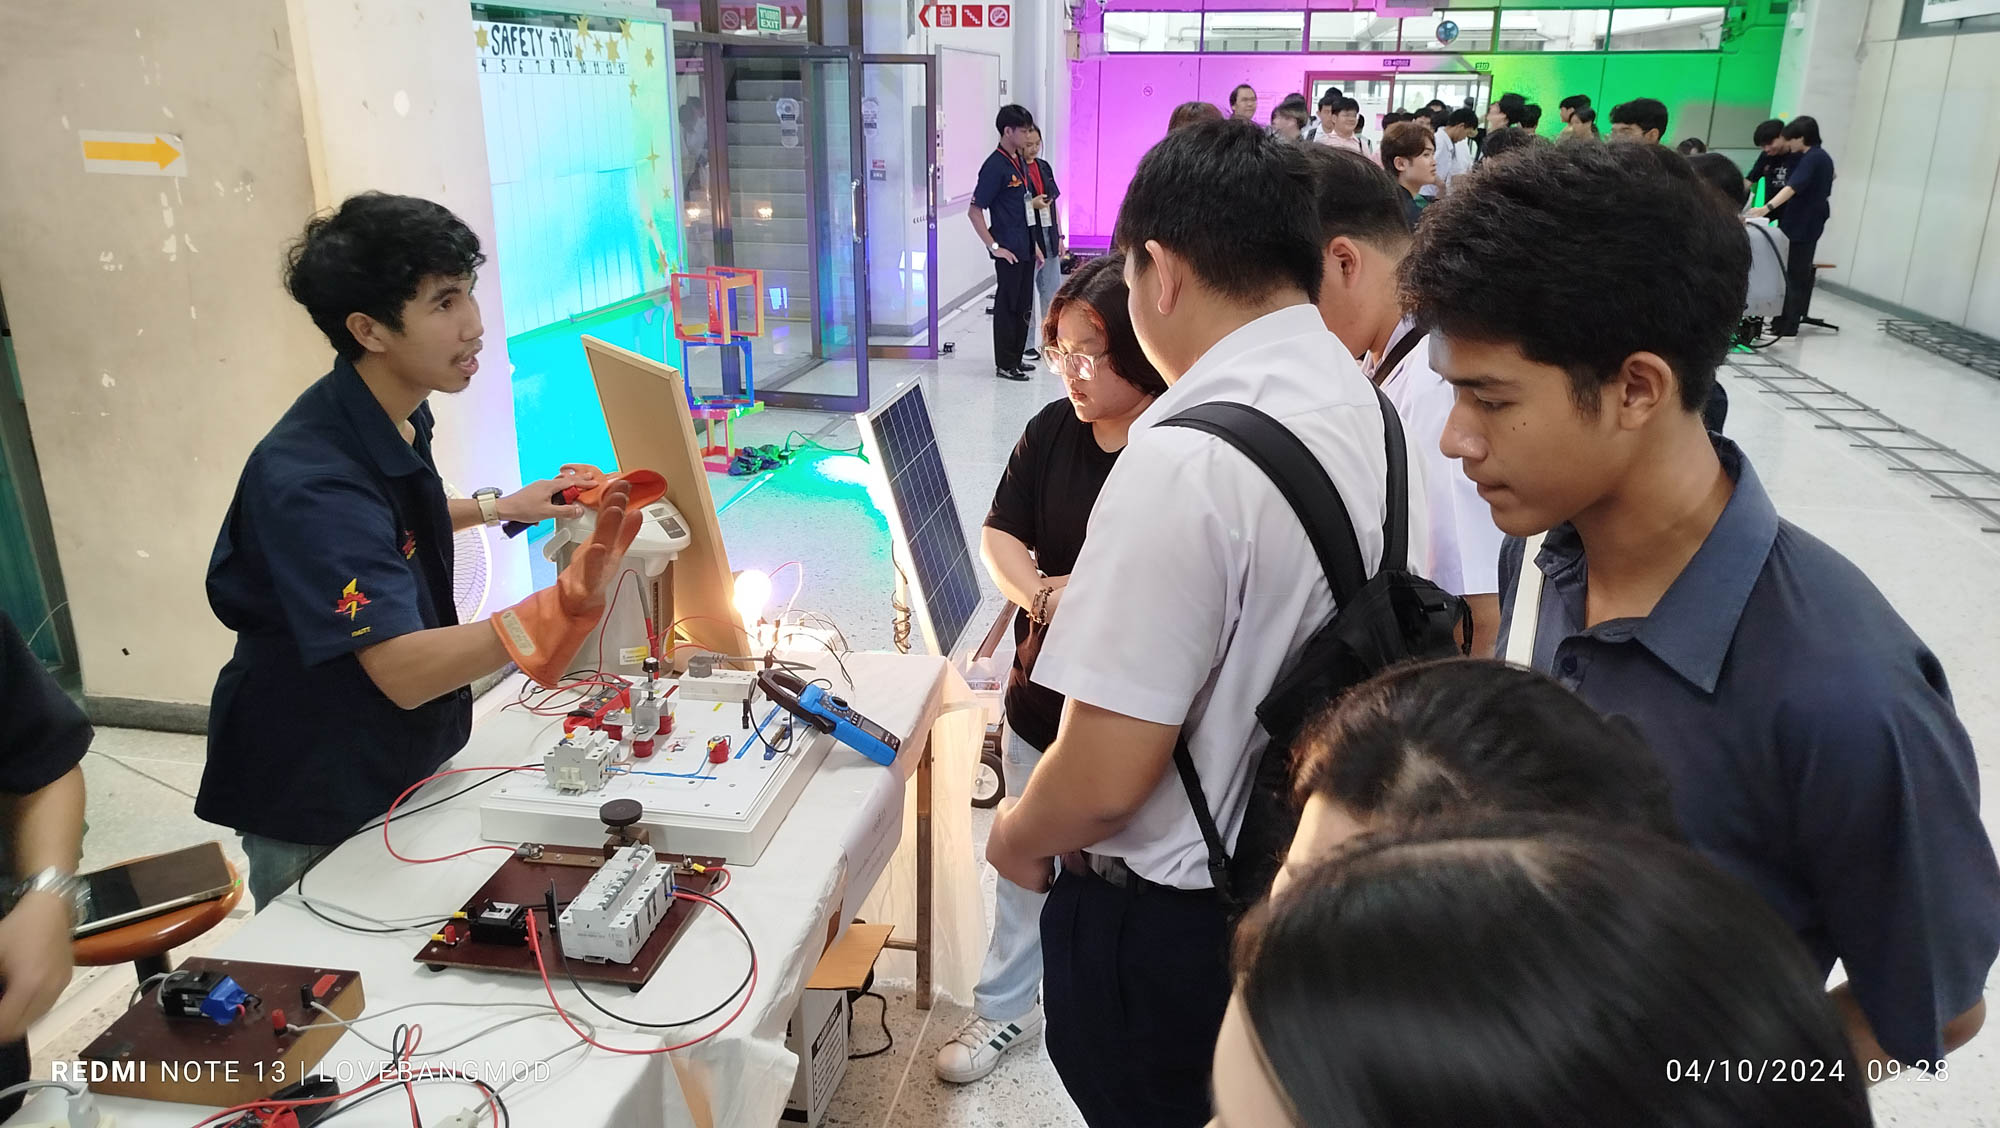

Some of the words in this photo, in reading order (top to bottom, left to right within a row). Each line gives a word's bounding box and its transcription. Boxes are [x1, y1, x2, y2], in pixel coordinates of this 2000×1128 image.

[761, 19, 779, 29] EXIT
[491, 24, 543, 57] SAFETY
[481, 59, 487, 72] 4
[501, 59, 507, 73] 5
[551, 59, 555, 74] 8
[566, 60, 571, 73] 9
[580, 60, 587, 74] 10
[593, 60, 600, 74] 11
[606, 61, 613, 74] 12
